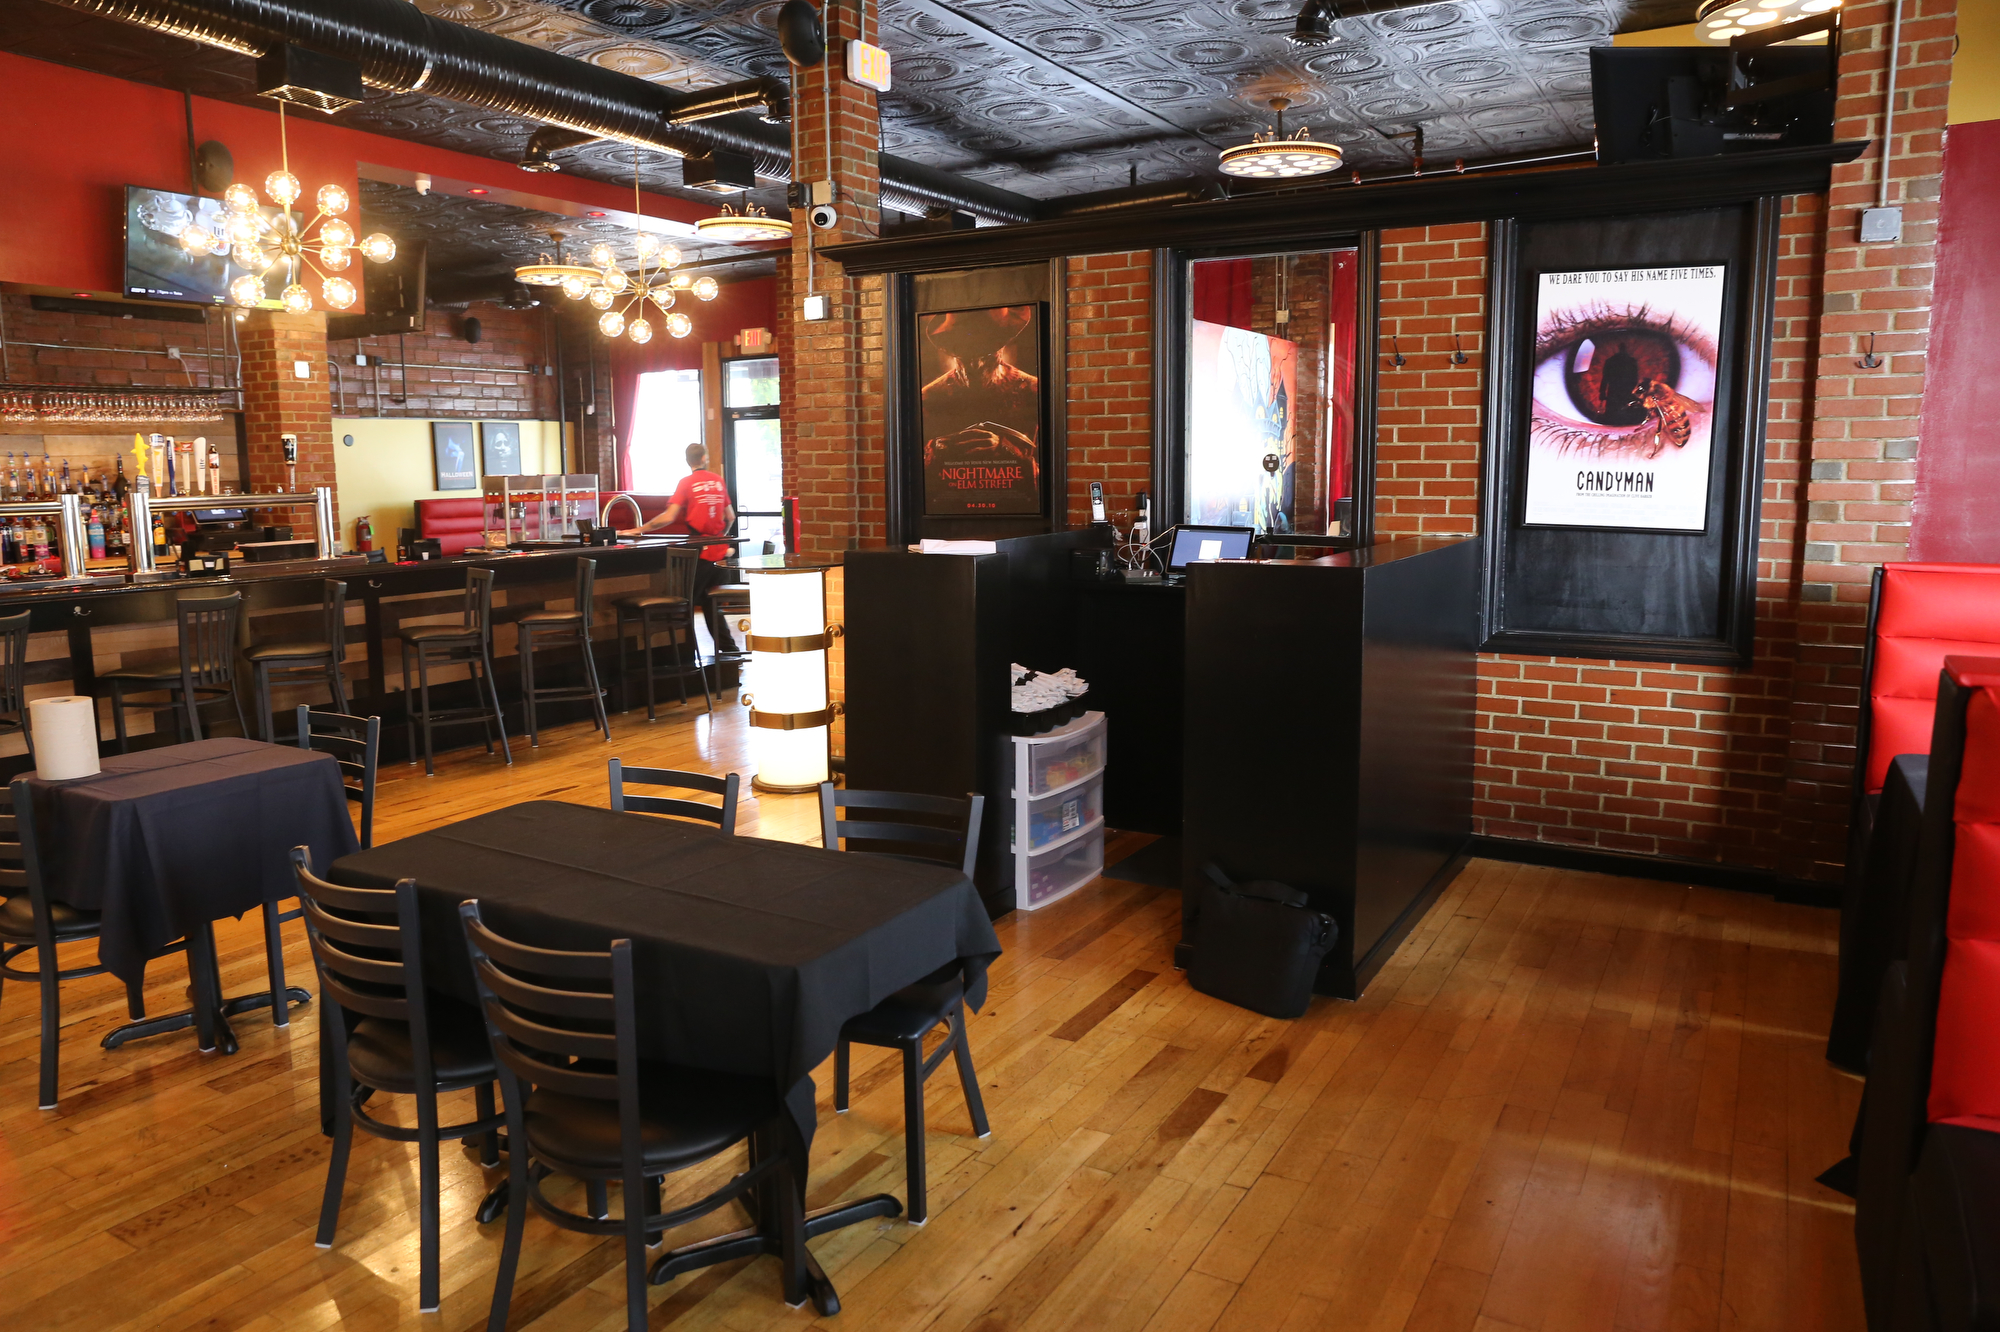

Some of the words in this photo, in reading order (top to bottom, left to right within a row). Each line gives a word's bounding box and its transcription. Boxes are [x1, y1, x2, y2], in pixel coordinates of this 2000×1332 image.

[861, 43, 887, 86] EXIT
[1549, 274, 1560, 285] WE
[1563, 273, 1582, 285] DARE
[1584, 272, 1600, 284] YOU
[1602, 272, 1612, 283] TO
[1614, 271, 1629, 282] SAY
[1631, 270, 1644, 281] HIS
[1646, 269, 1668, 281] NAME
[1670, 268, 1688, 280] FIVE
[1691, 267, 1716, 279] TIMES.
[744, 330, 762, 347] EXIT
[942, 466, 1024, 480] NIGHTMARE
[1577, 470, 1654, 492] CANDYMAN
[957, 480, 977, 489] ELM
[979, 479, 1014, 488] STREET
